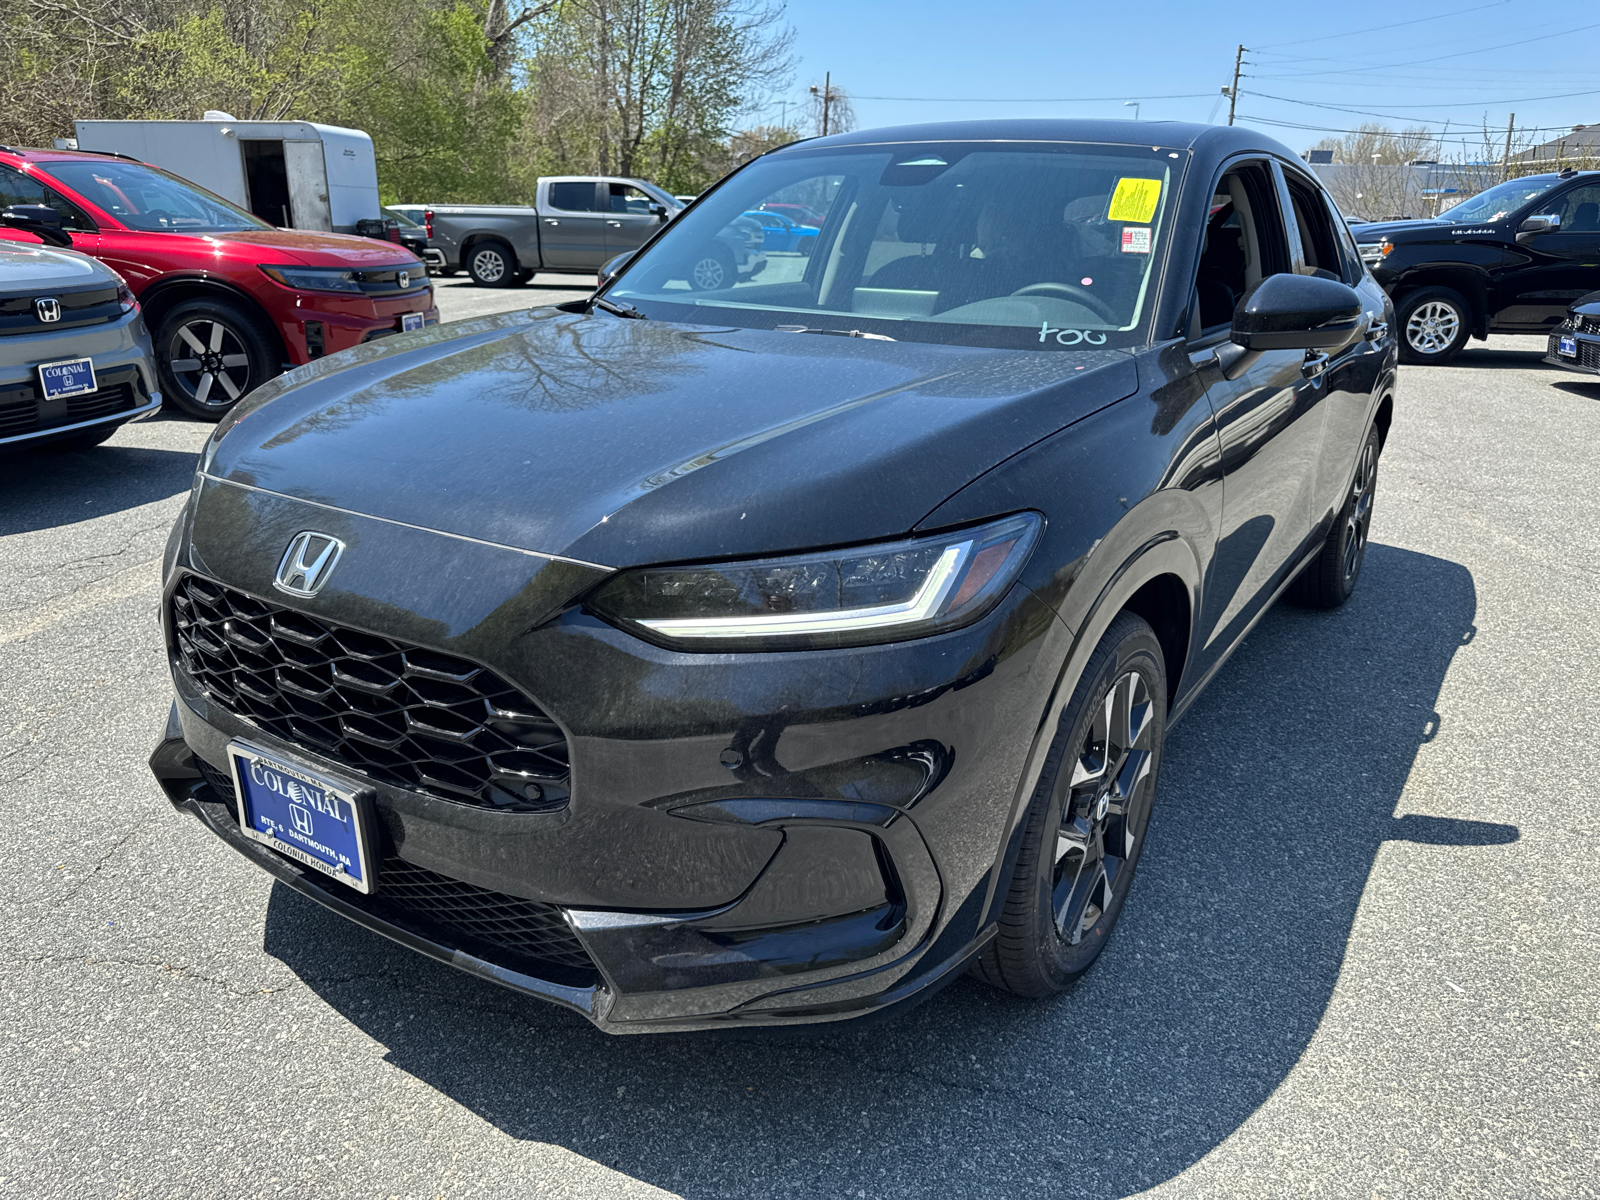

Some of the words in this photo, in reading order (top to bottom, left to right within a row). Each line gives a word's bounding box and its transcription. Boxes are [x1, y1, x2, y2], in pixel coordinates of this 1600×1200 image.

[46, 364, 86, 378] COLONIAL
[251, 766, 347, 823] COLONIAL
[273, 840, 310, 863] COLONIAL
[310, 858, 337, 877] HONDA
[278, 823, 285, 833] 6
[339, 853, 352, 867] MA
